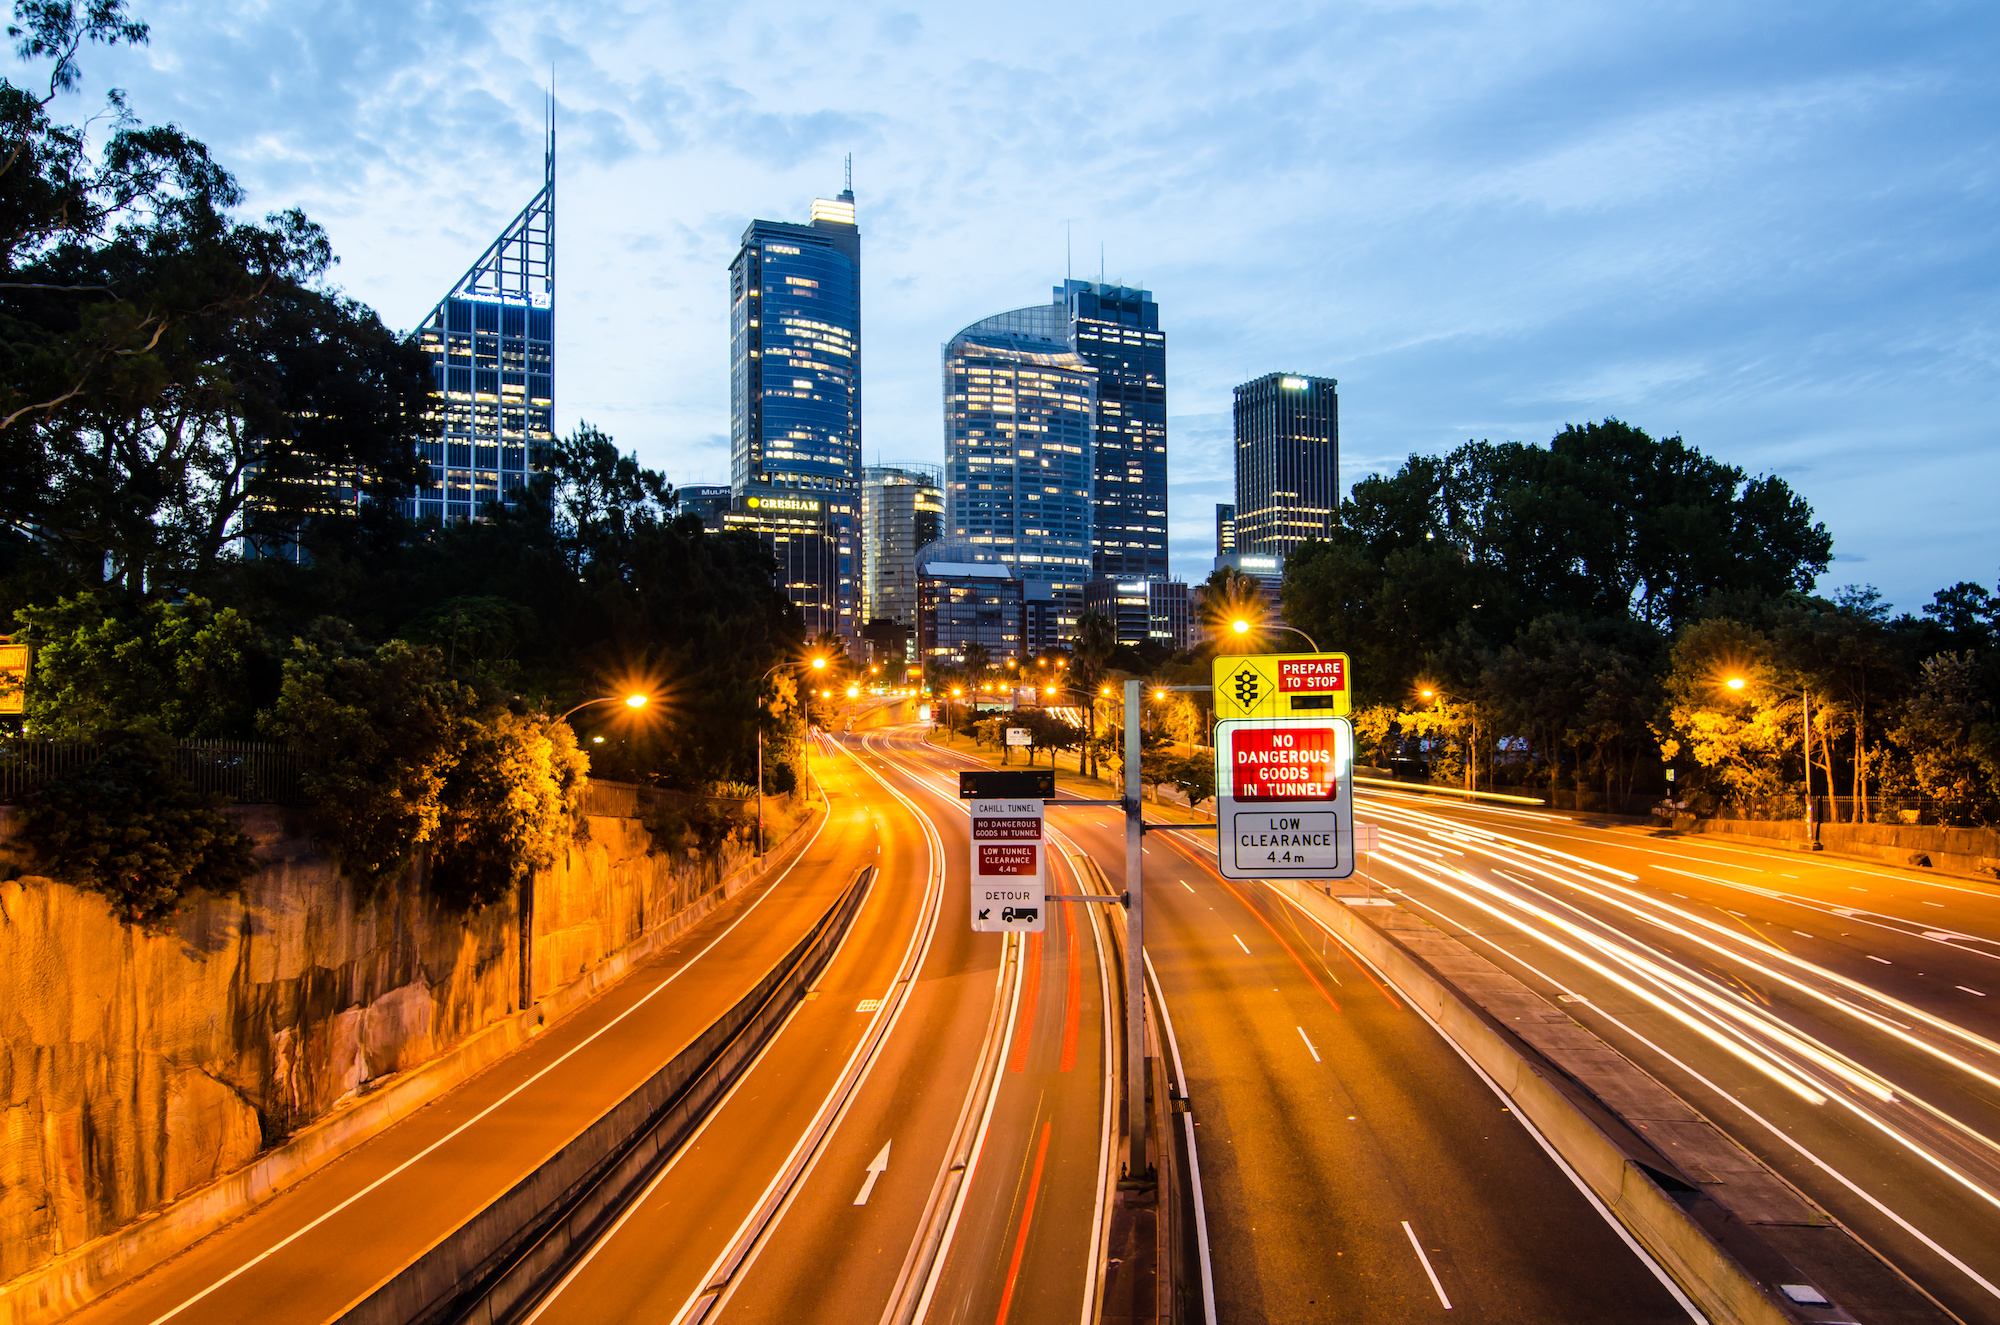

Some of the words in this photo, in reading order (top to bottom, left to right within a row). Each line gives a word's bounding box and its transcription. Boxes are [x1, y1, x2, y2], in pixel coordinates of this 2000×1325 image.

[760, 499, 819, 511] GRESHAM
[1283, 663, 1340, 674] PREPARE
[1286, 678, 1301, 687] TO
[1307, 677, 1337, 687] STOP
[1273, 735, 1293, 747] NO
[1238, 750, 1330, 764] DANGEROUS
[1259, 767, 1309, 780] GOODS
[1243, 784, 1257, 796] IN
[1268, 783, 1326, 796] TUNNEL
[1270, 819, 1300, 830] LOW
[1241, 834, 1330, 847] CLEARANCE
